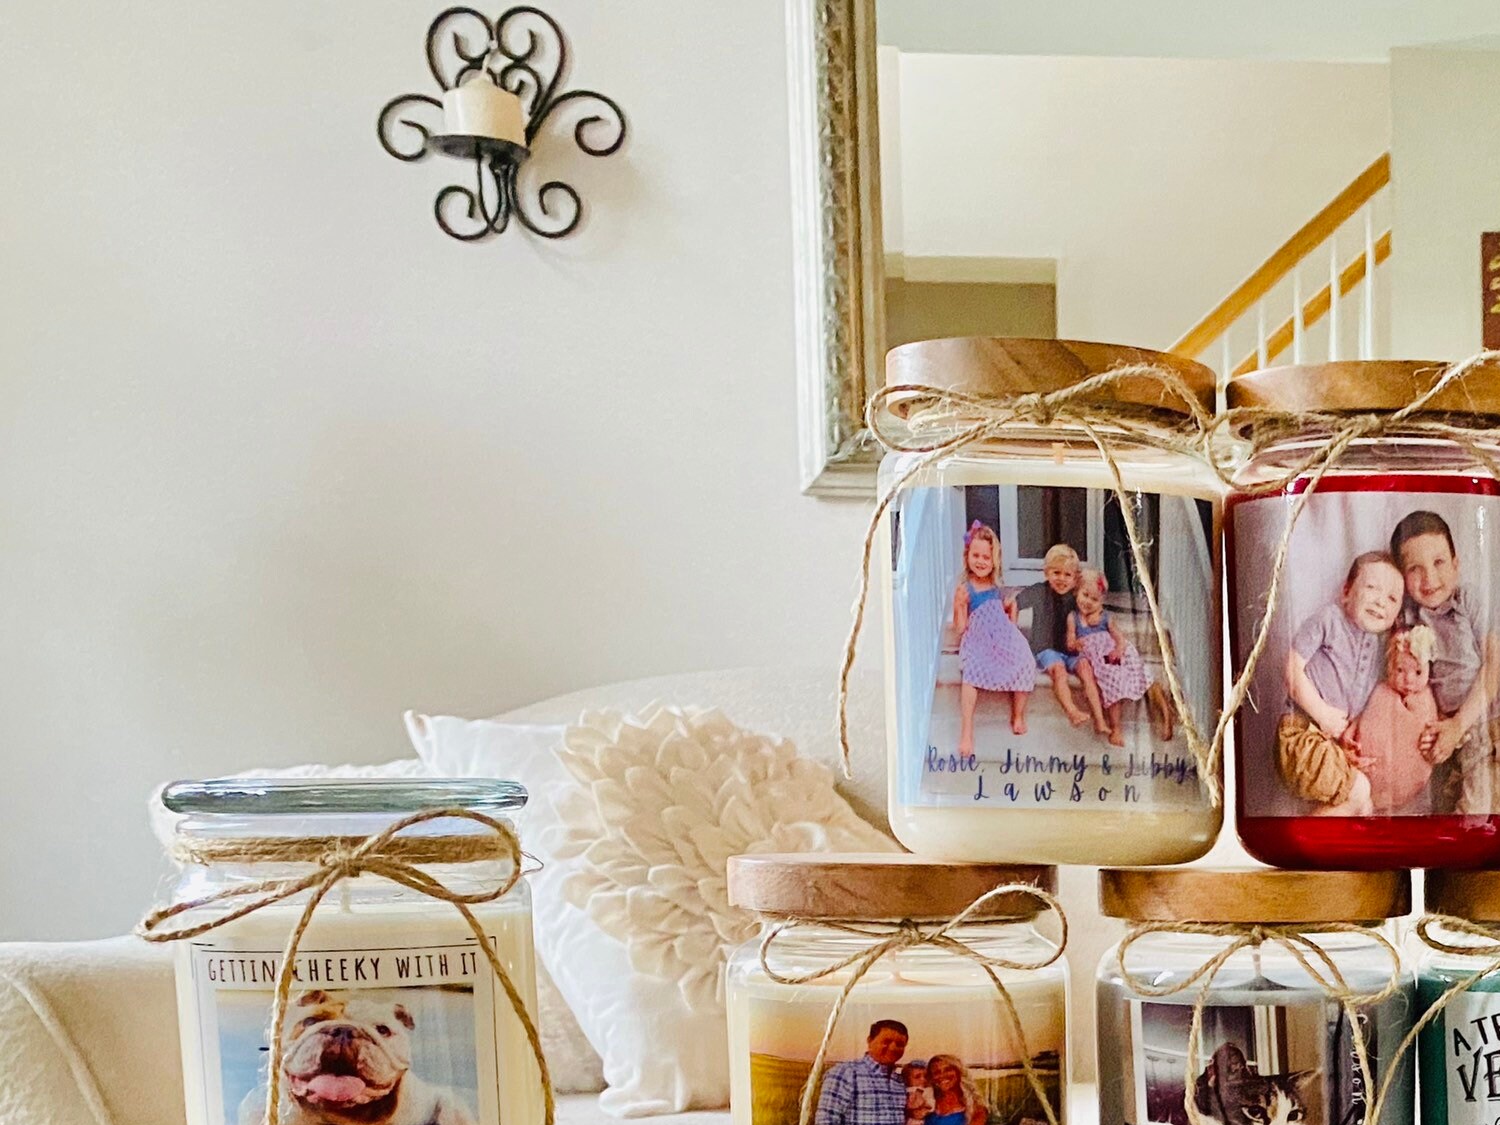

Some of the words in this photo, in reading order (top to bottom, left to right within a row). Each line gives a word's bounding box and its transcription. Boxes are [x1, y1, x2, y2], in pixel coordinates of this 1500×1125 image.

[1000, 748, 1088, 782] Jimmy
[1102, 754, 1112, 776] &
[974, 775, 1140, 803] Lawson
[208, 958, 276, 983] GETTIN
[292, 957, 380, 983] CHEEKY
[396, 954, 449, 979] WITH
[460, 952, 477, 975] IT
[1453, 1027, 1472, 1057] A
